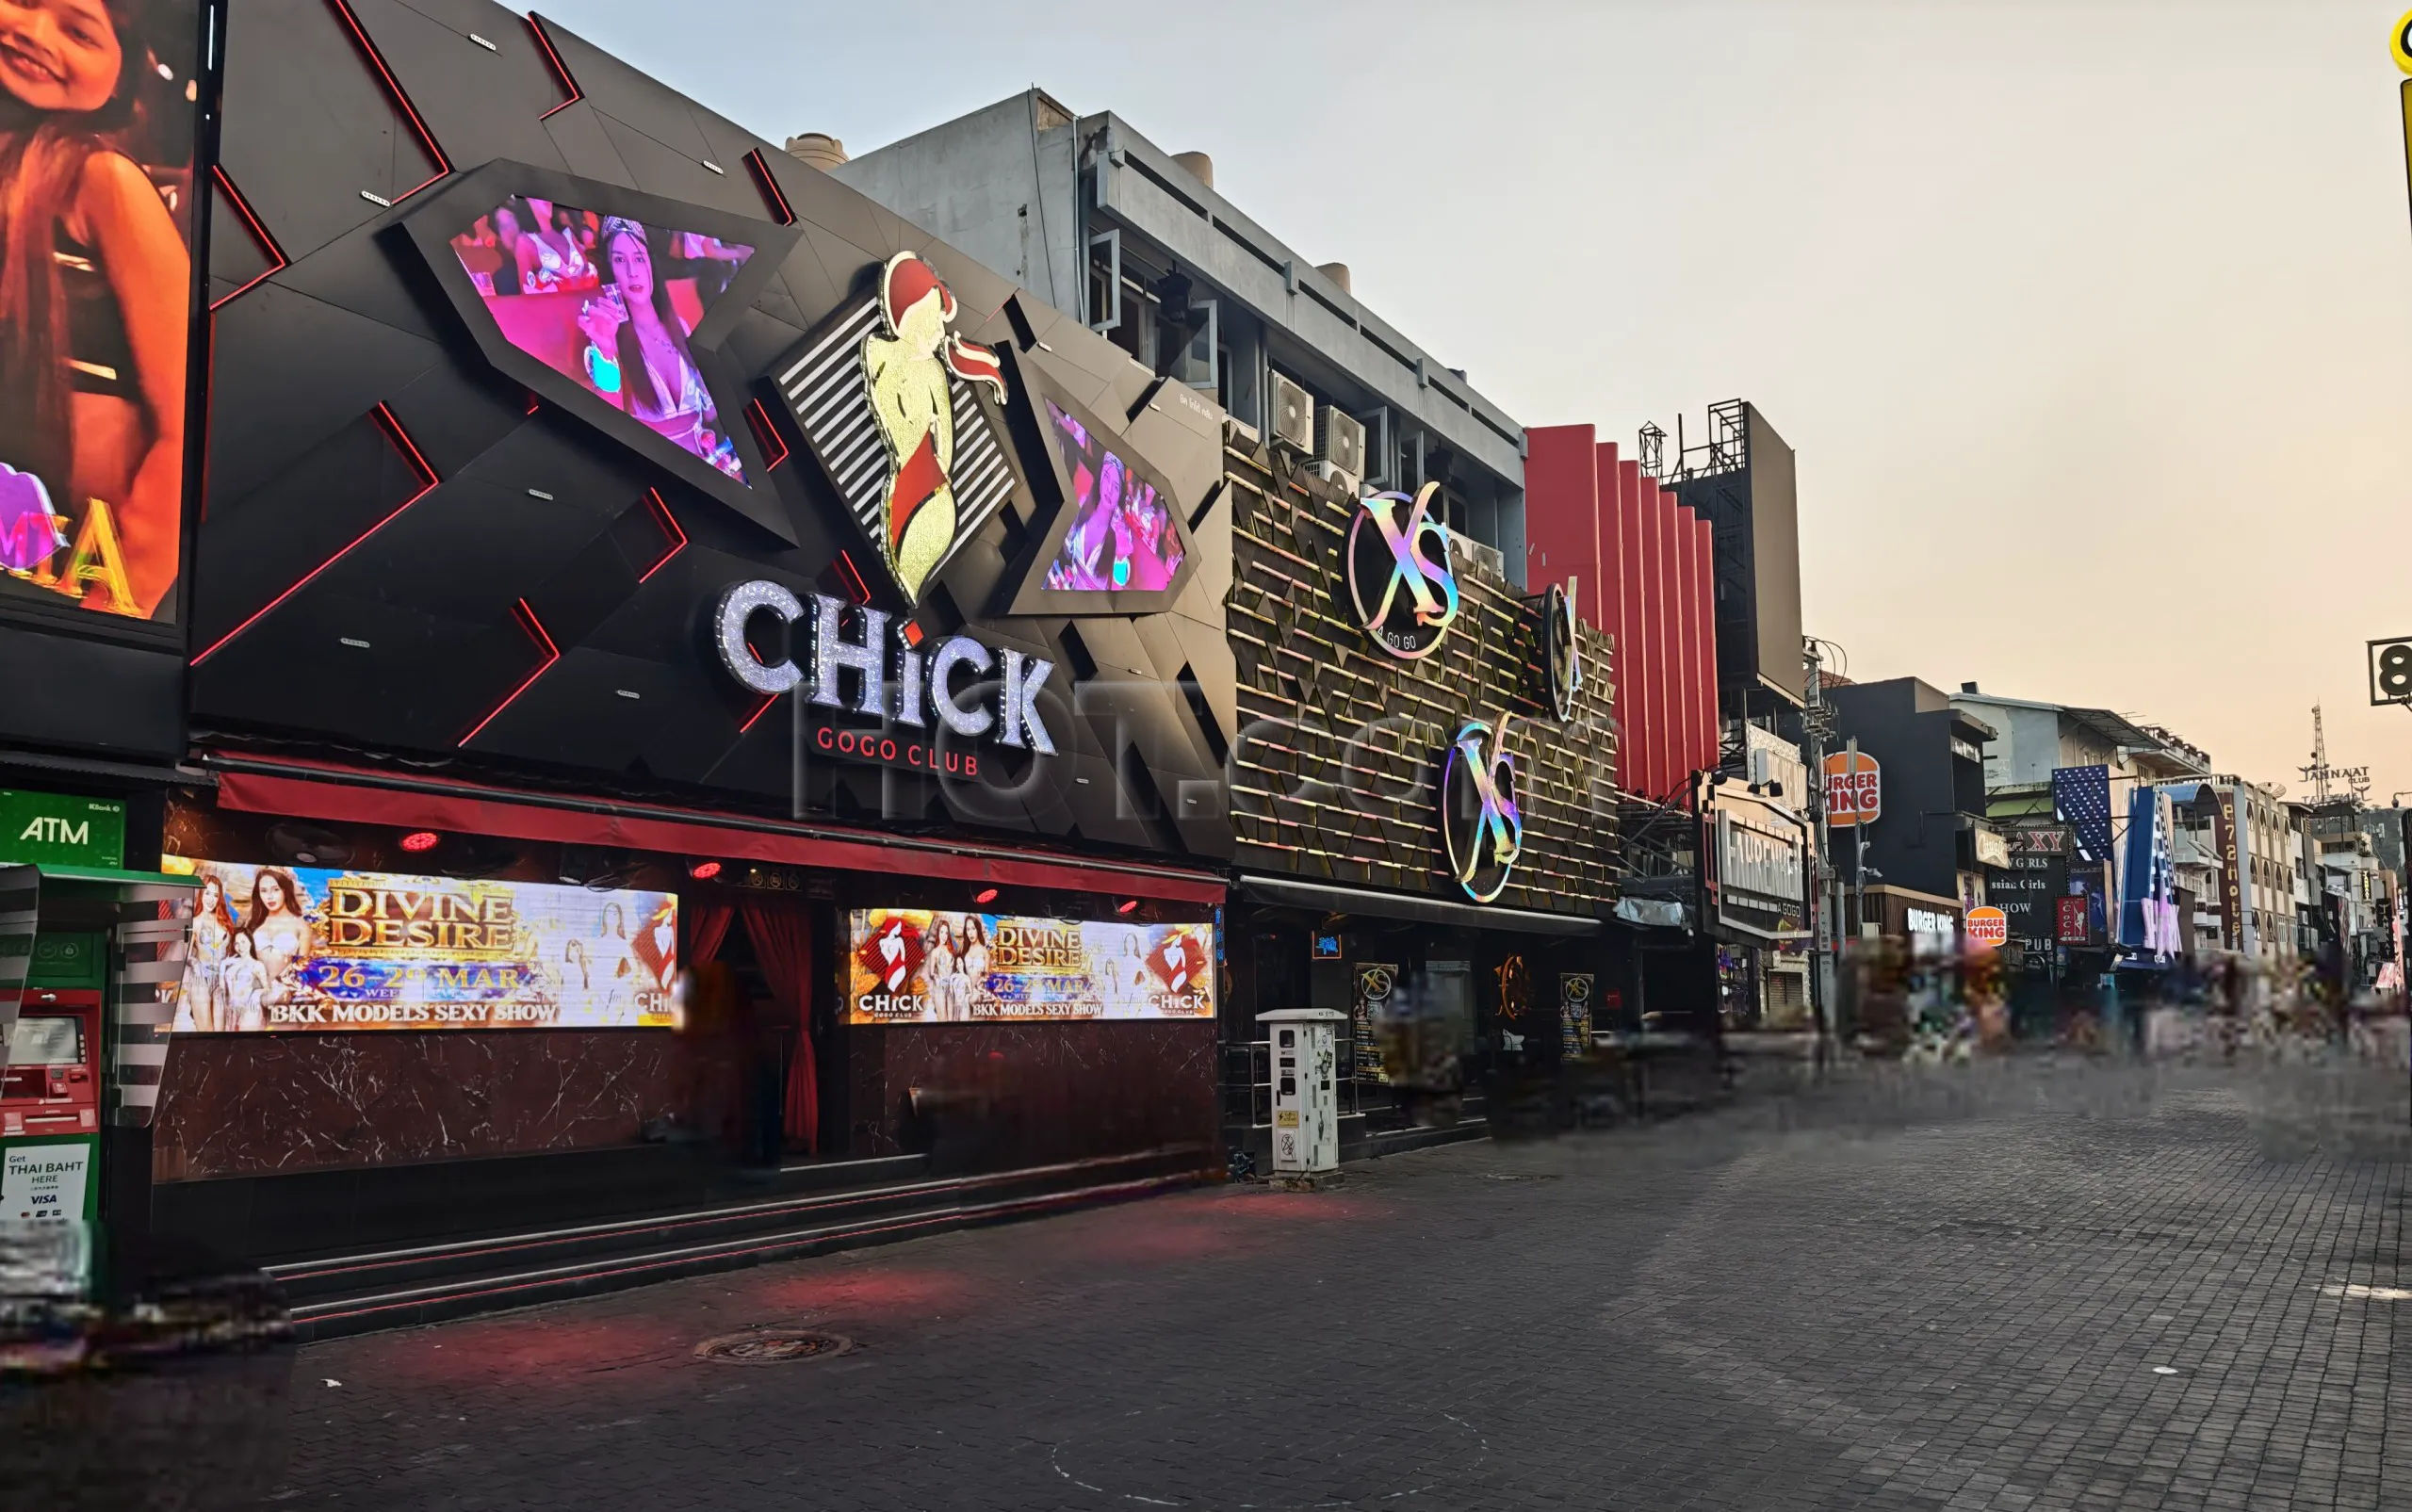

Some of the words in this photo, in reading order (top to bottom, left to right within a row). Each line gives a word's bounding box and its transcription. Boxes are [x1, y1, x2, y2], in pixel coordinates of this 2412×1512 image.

[1359, 481, 1459, 630] XS
[1387, 632, 1400, 648] GO
[1404, 635, 1416, 650] GO
[817, 726, 896, 760] GOGO
[908, 743, 979, 776] CLUB
[1824, 773, 1878, 790] URGER
[1455, 710, 1523, 883] XS
[1826, 789, 1878, 812] ING
[20, 816, 90, 845] ATM
[2016, 858, 2048, 869] GRLS
[1992, 879, 2017, 889] ssian
[329, 888, 514, 923] DIVINE
[1996, 902, 2030, 913] HOW
[1908, 907, 1936, 933] BURGER
[1936, 912, 1954, 934] KING
[1967, 919, 2005, 928] BURGER
[329, 918, 514, 951] DESIRE
[997, 927, 1082, 950] DIVINE
[1967, 927, 2005, 938] KING
[2025, 938, 2052, 951] PUB
[997, 947, 1082, 967] DESIRE
[436, 967, 519, 989] MAR
[1046, 979, 1085, 994] MAR
[269, 1004, 327, 1023] BKK
[332, 1004, 429, 1022] MODELS
[434, 1004, 490, 1022] SEXY
[495, 1003, 561, 1021] SHOW
[972, 1004, 998, 1016] BKK
[1000, 1003, 1044, 1016] MODELS
[1046, 1003, 1071, 1016] SEXY
[1073, 1003, 1103, 1016] SHOW
[9, 1163, 42, 1176] THAI
[45, 1161, 84, 1173] BAHT
[31, 1175, 58, 1184] HERE
[31, 1195, 57, 1205] VISA
